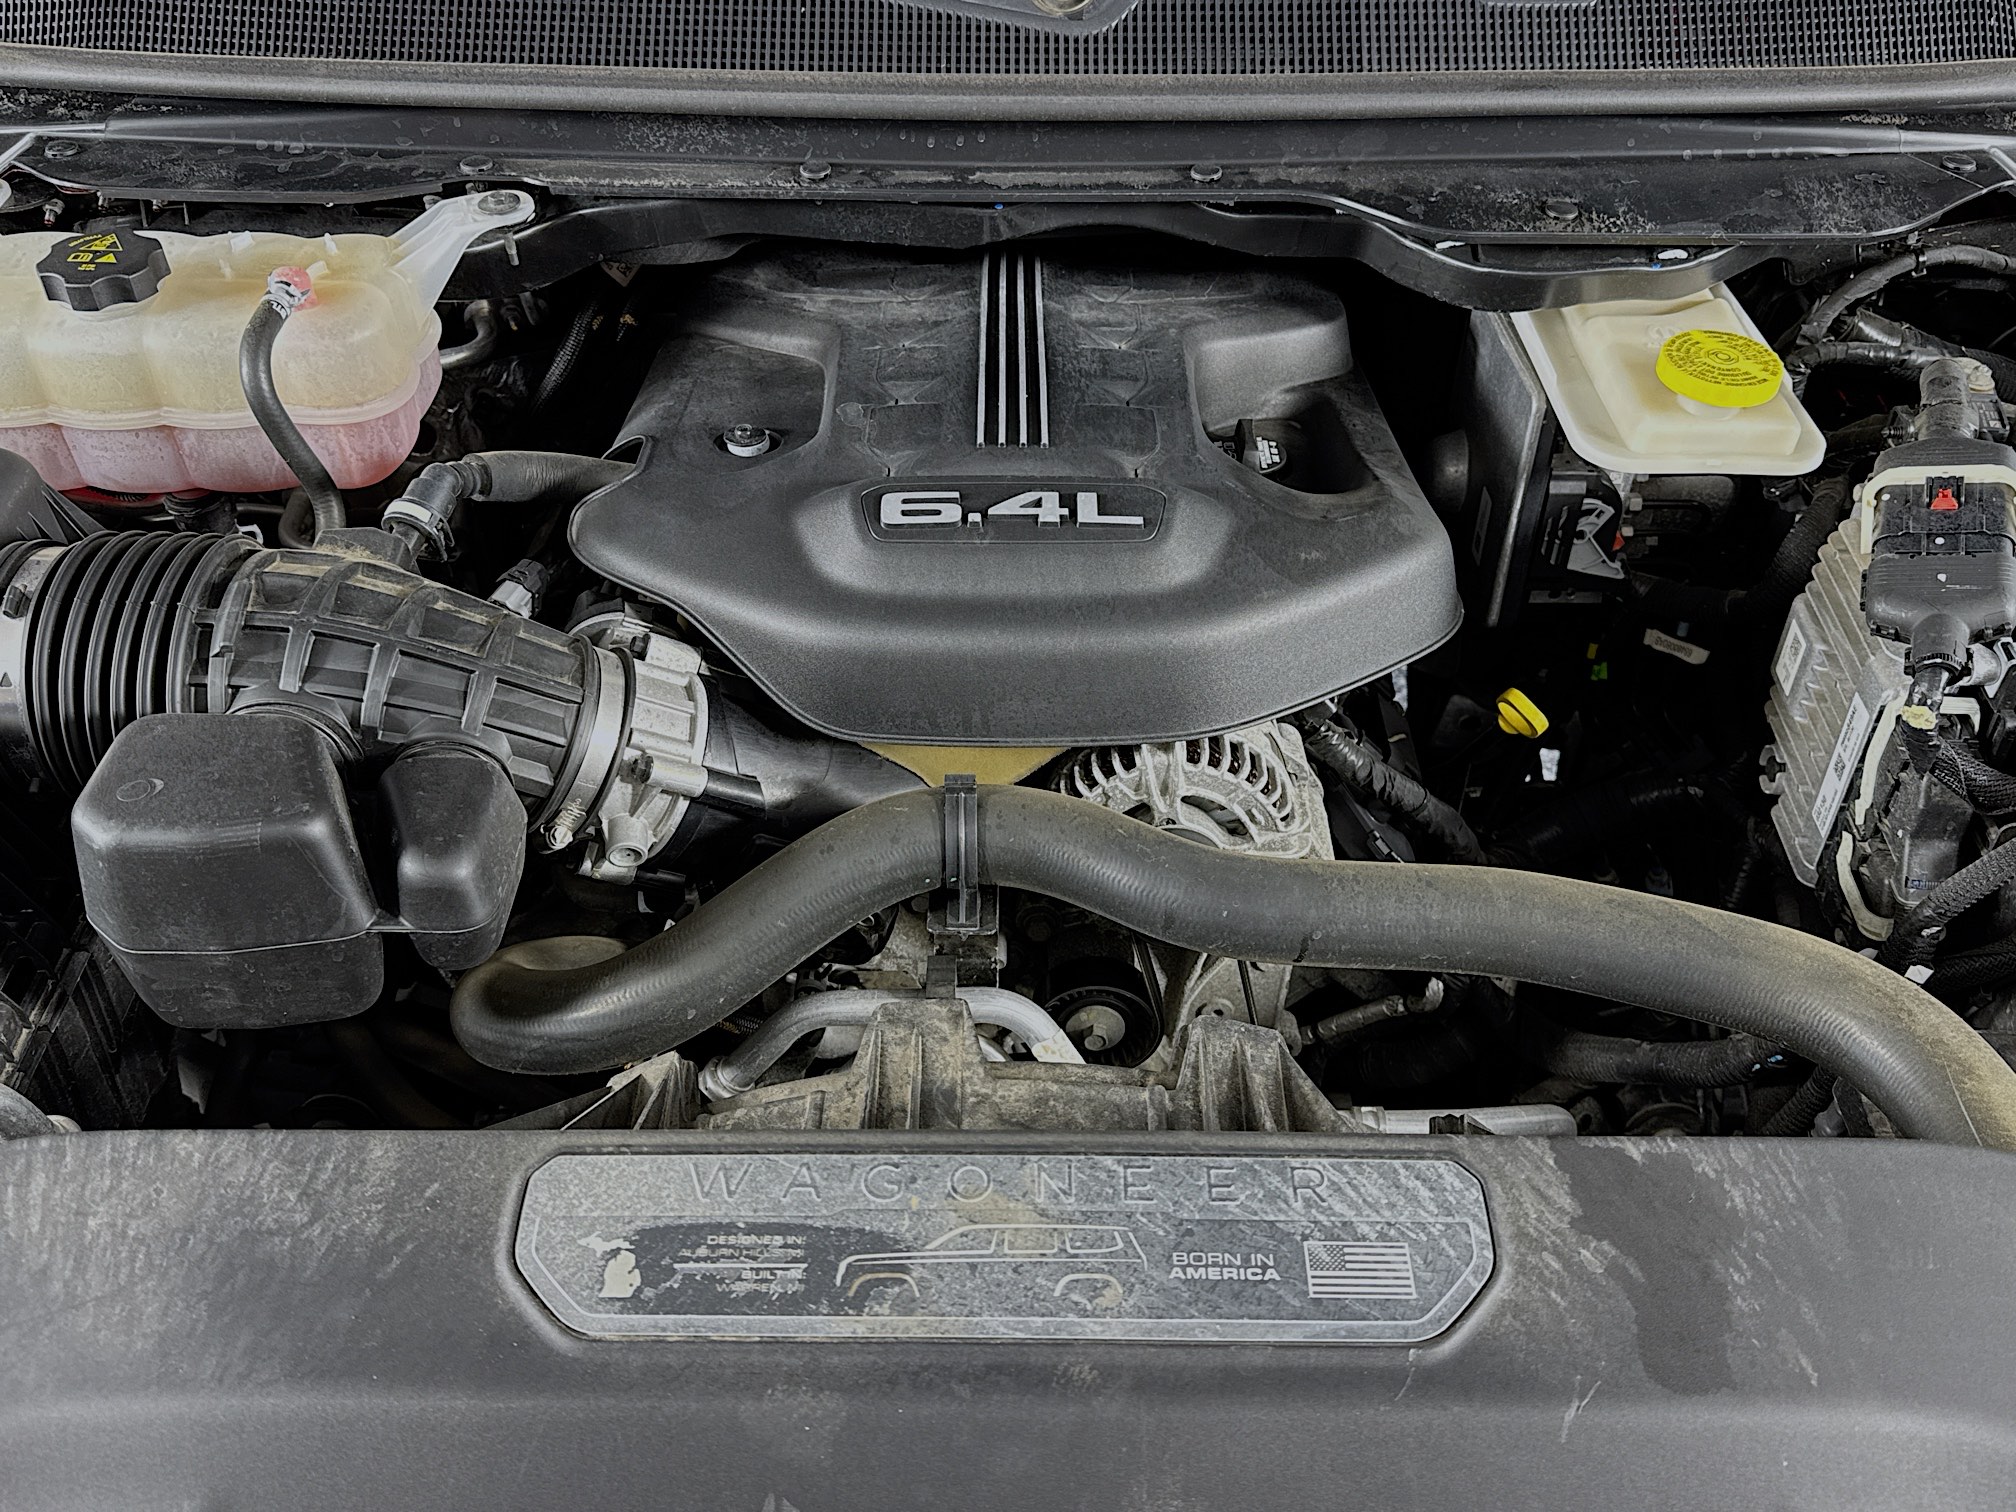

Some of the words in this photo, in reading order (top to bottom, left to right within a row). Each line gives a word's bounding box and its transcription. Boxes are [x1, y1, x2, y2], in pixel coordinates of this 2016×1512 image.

[880, 491, 1145, 529] 6.4L
[690, 1162, 1330, 1206] WAGONEER
[706, 1234, 784, 1245] DESIGNED
[678, 1247, 739, 1257] AUBURN
[1172, 1251, 1242, 1266] BORN
[1250, 1253, 1275, 1267] IN
[741, 1268, 785, 1280] BUILT
[1168, 1266, 1282, 1281] AMERICA
